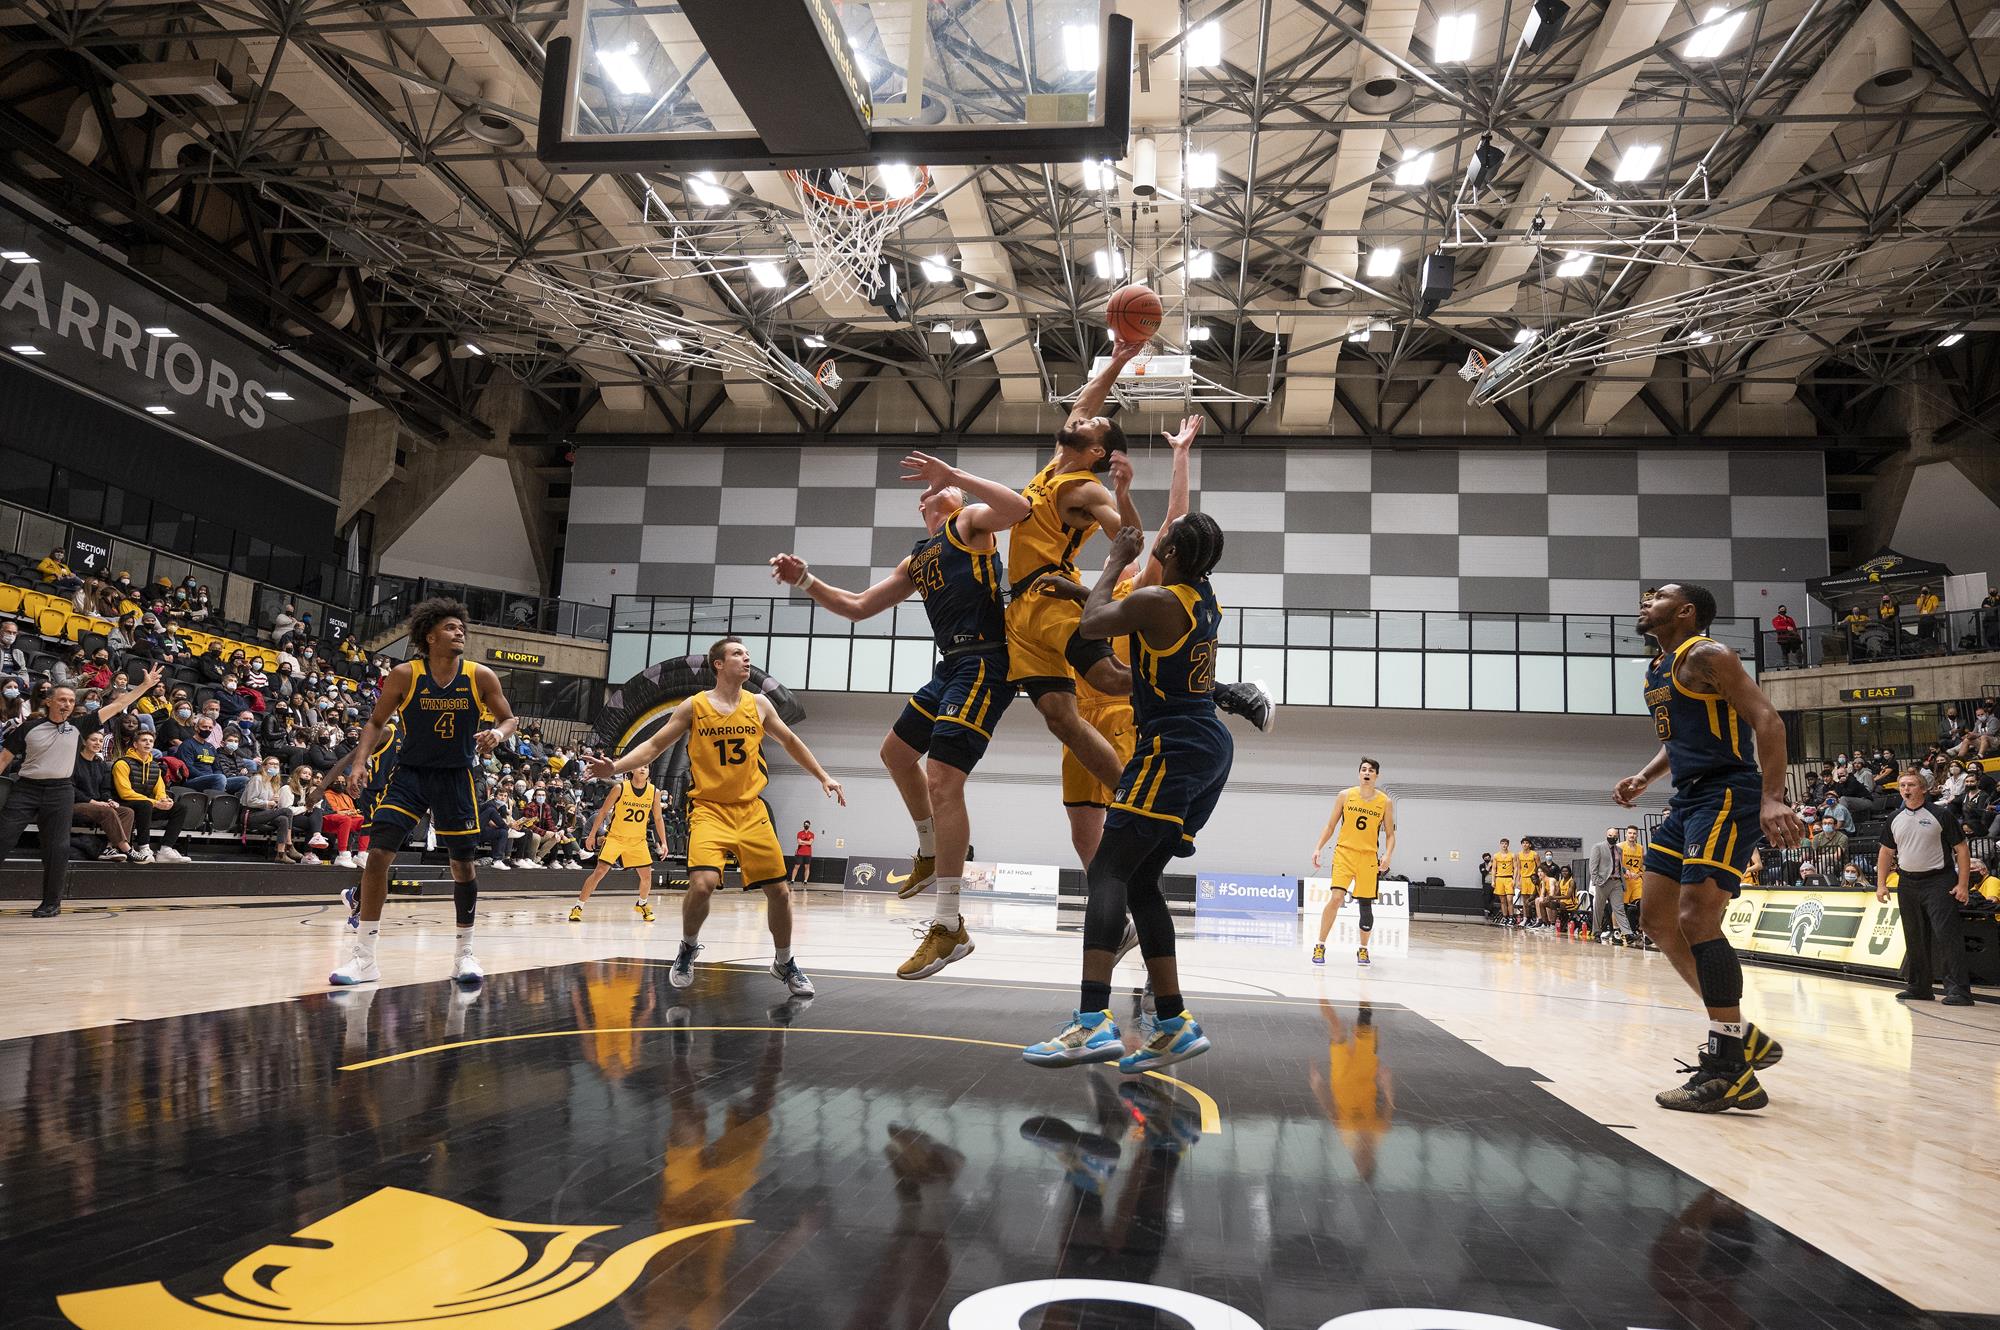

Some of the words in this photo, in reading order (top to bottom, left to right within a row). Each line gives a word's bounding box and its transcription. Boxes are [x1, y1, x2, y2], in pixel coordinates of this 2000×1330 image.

[0, 258, 267, 429] ARRIORS
[76, 541, 106, 556] SECTION
[84, 554, 95, 568] 4
[329, 618, 347, 628] SECTION
[334, 626, 340, 638] 2
[507, 652, 539, 663] NORTH
[1868, 687, 1897, 697] EAST
[420, 698, 469, 710] WINDSOR
[434, 712, 455, 738] 4
[698, 726, 756, 736] WARRIORS
[713, 738, 747, 766] 13
[623, 808, 645, 822] 20
[1347, 806, 1381, 818] WARRIORS
[1355, 815, 1368, 830] 6
[1626, 858, 1640, 868] 42
[1219, 882, 1295, 902] #Someday
[1730, 911, 1752, 923] OUA
[1872, 926, 1895, 937] SPORTS
